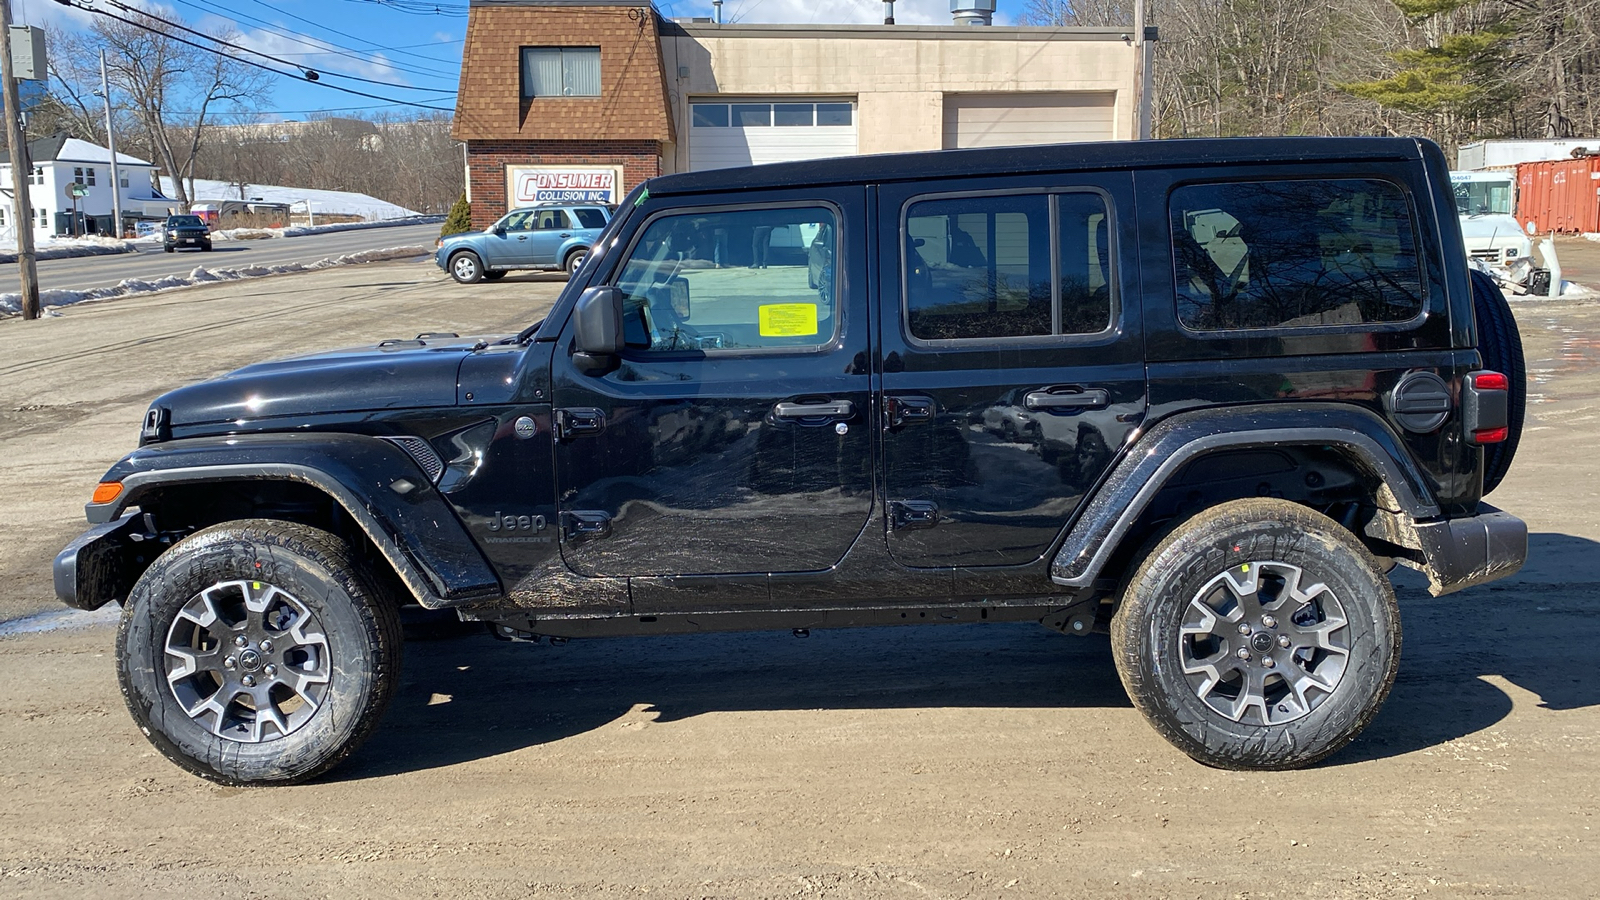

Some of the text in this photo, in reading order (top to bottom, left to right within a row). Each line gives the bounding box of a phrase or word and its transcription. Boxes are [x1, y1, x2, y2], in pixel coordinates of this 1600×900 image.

[517, 173, 612, 201] CONSUMER
[539, 191, 605, 200] COLLISION INC.
[486, 511, 546, 533] Jeep
